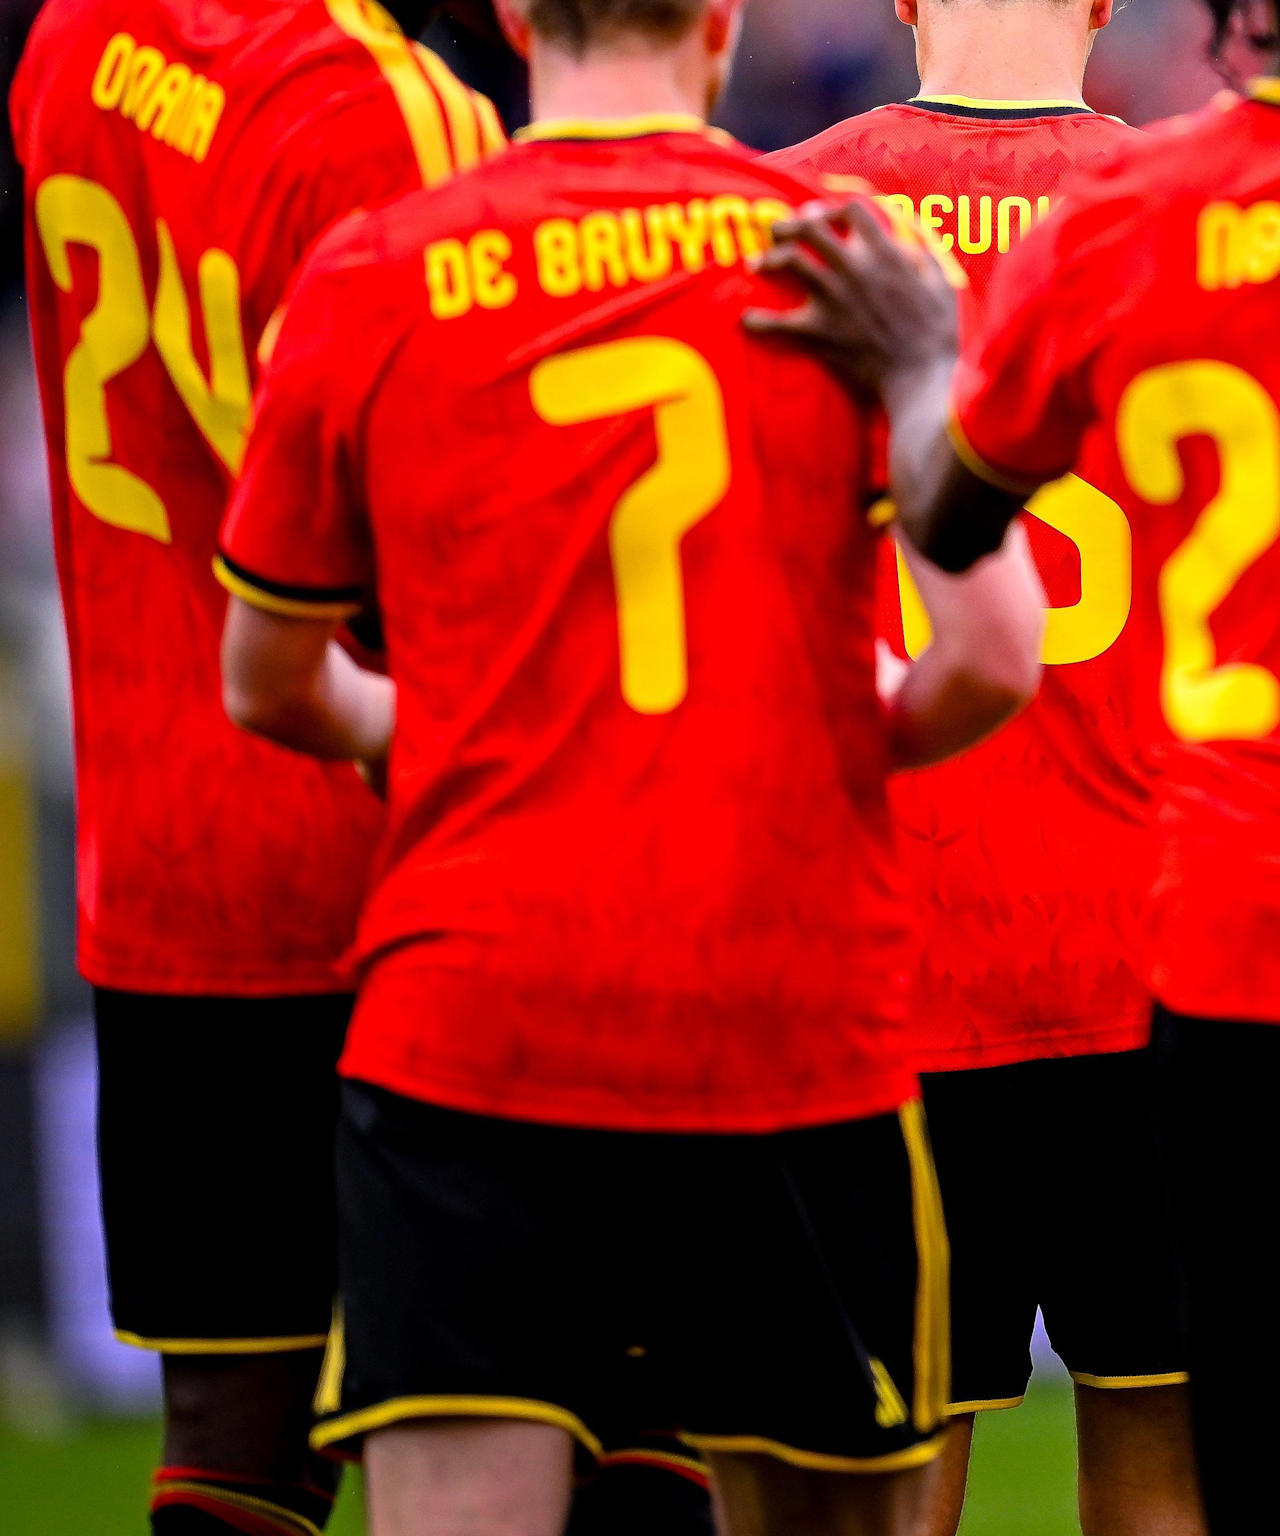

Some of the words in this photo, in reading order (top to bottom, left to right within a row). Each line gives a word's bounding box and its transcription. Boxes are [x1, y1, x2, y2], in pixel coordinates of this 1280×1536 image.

[36, 173, 252, 545] 24
[424, 229, 518, 321] DE
[528, 335, 731, 715] 7
